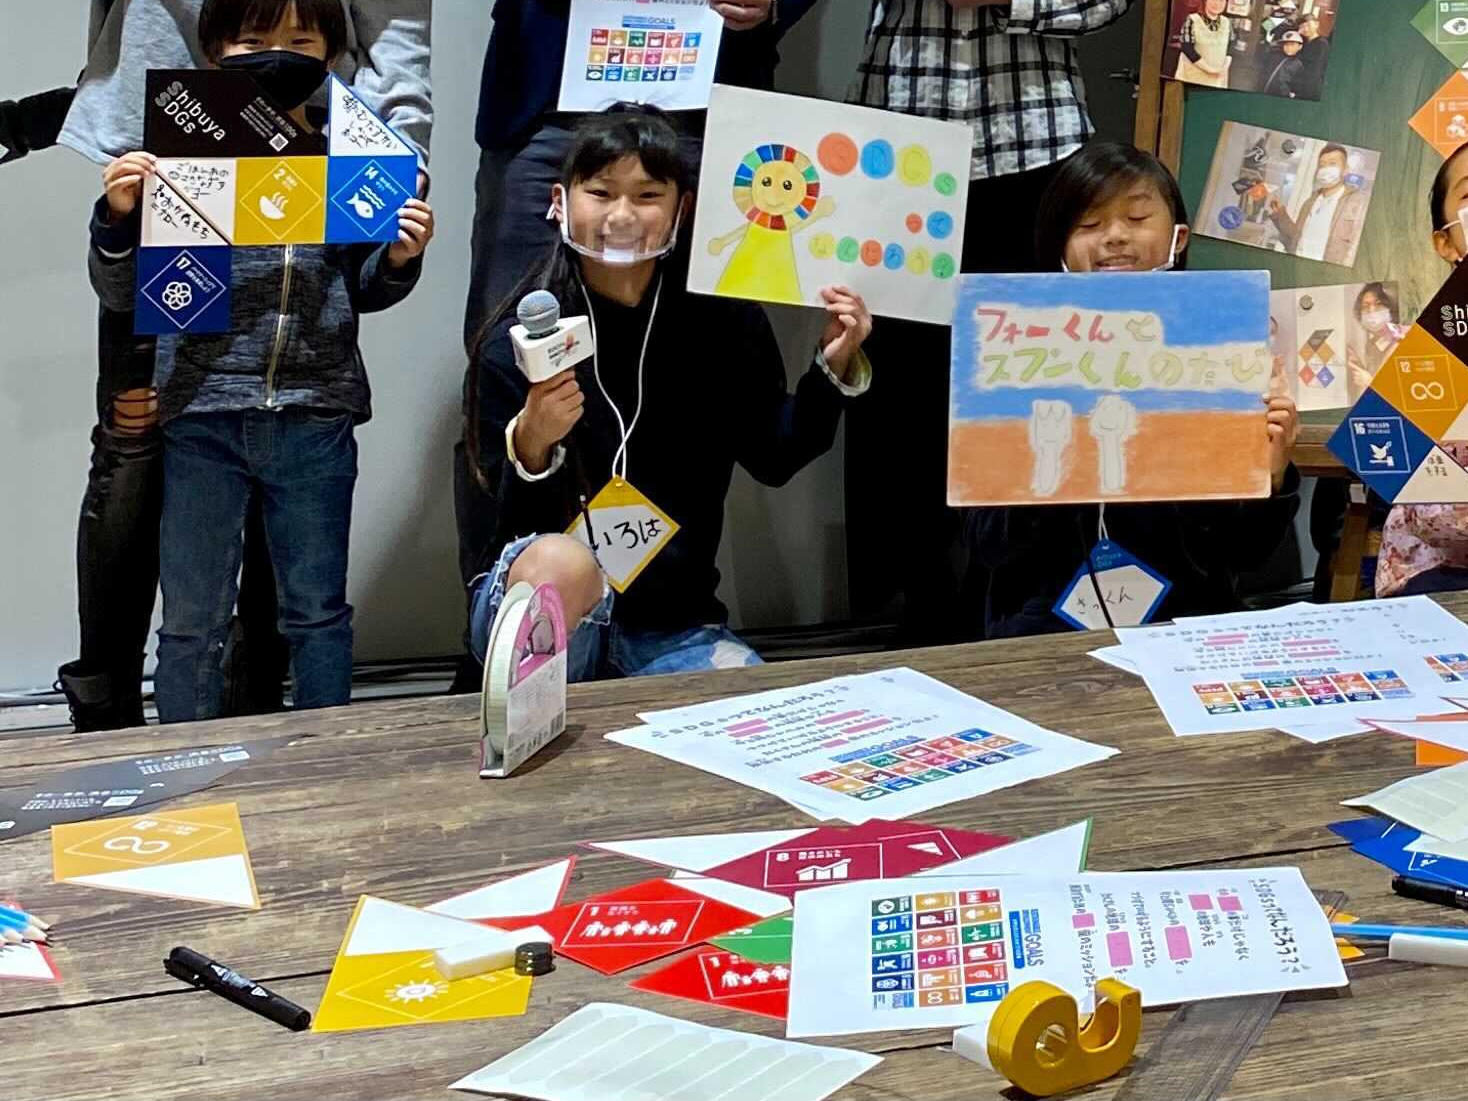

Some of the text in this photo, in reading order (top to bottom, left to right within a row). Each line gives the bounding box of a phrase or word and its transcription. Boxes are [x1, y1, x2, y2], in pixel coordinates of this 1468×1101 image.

[154, 91, 198, 135] SDGs
[167, 80, 227, 142] Shibuya
[1025, 933, 1044, 967] GOALS
